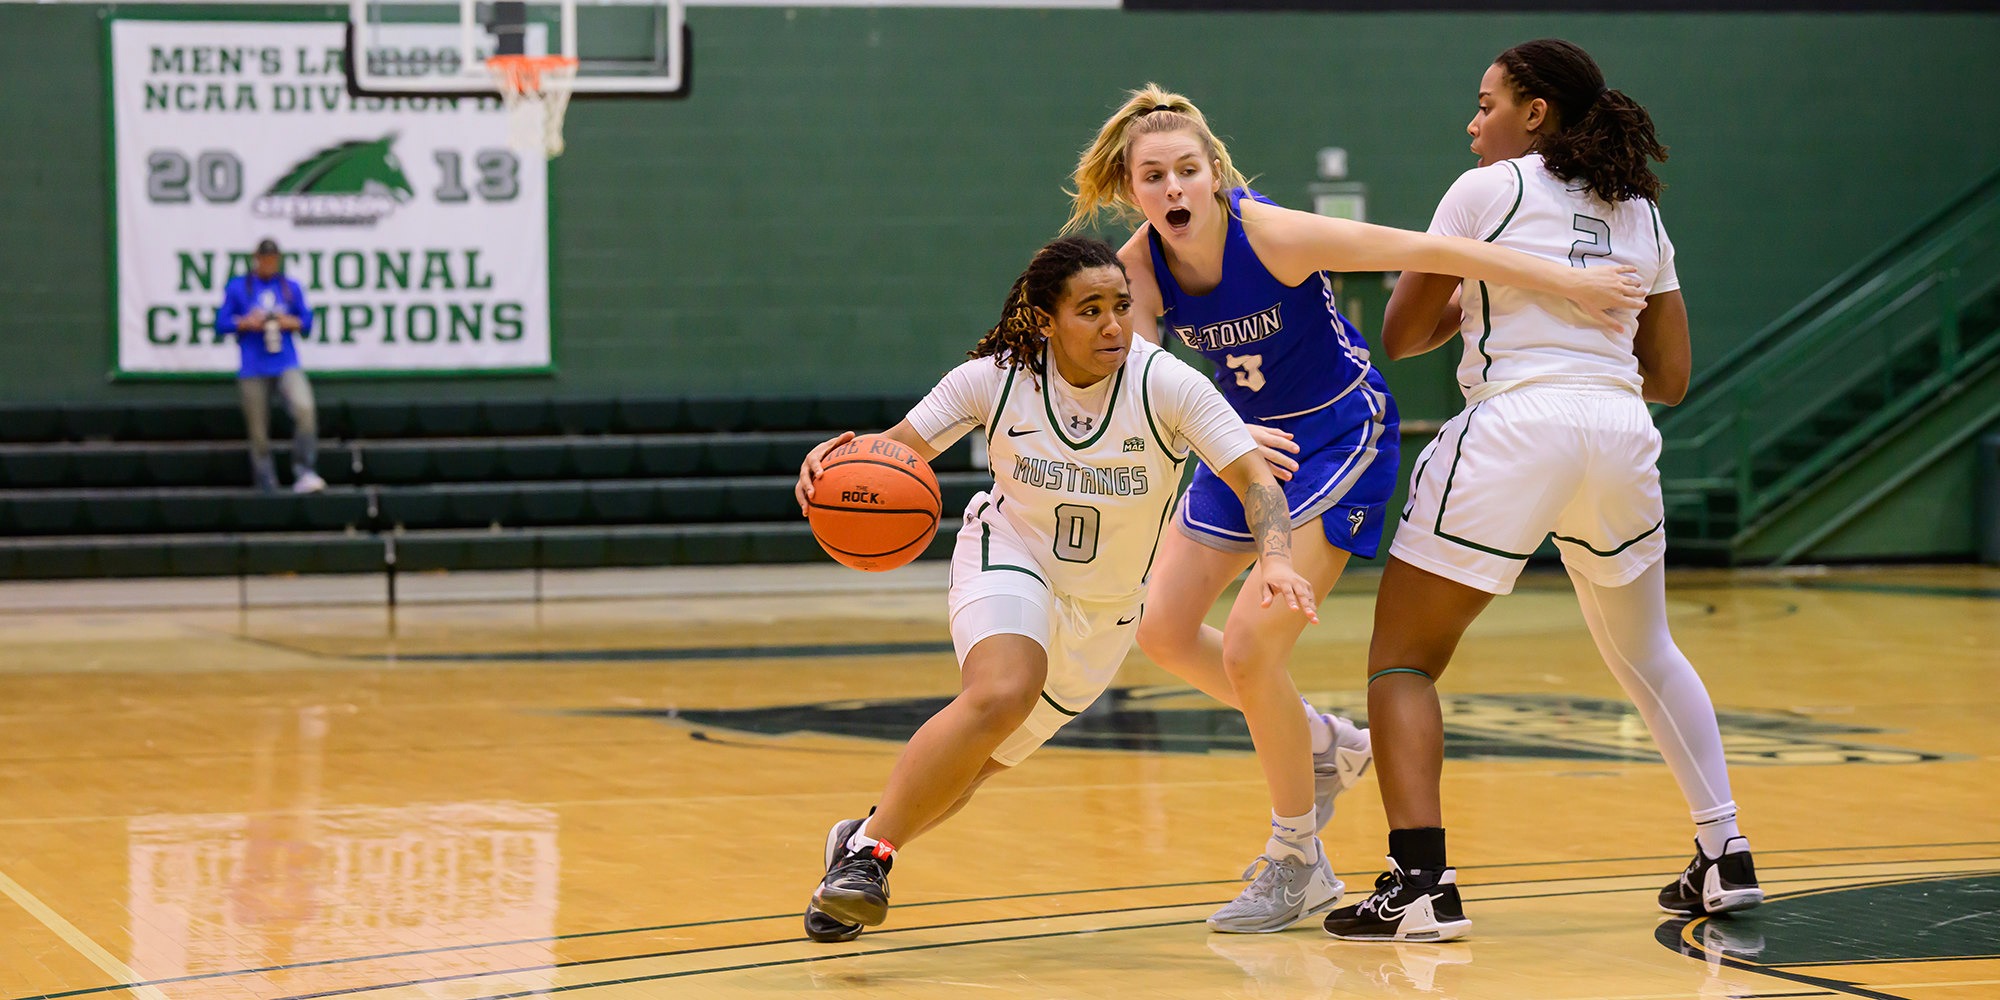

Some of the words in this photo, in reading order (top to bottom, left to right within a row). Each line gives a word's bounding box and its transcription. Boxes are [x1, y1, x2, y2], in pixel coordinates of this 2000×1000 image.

[150, 46, 281, 75] MEN'S
[144, 83, 258, 111] NCAA
[148, 151, 242, 203] 20
[434, 149, 519, 203] 13
[1568, 213, 1612, 269] 2
[1173, 302, 1283, 352] E-TOWN
[1226, 353, 1266, 392] 3
[869, 439, 918, 469] ROCK
[1123, 443, 1145, 452] MAC
[1012, 453, 1149, 496] MUSTANGS
[841, 491, 880, 504] ROCK
[1053, 502, 1100, 564] 0
